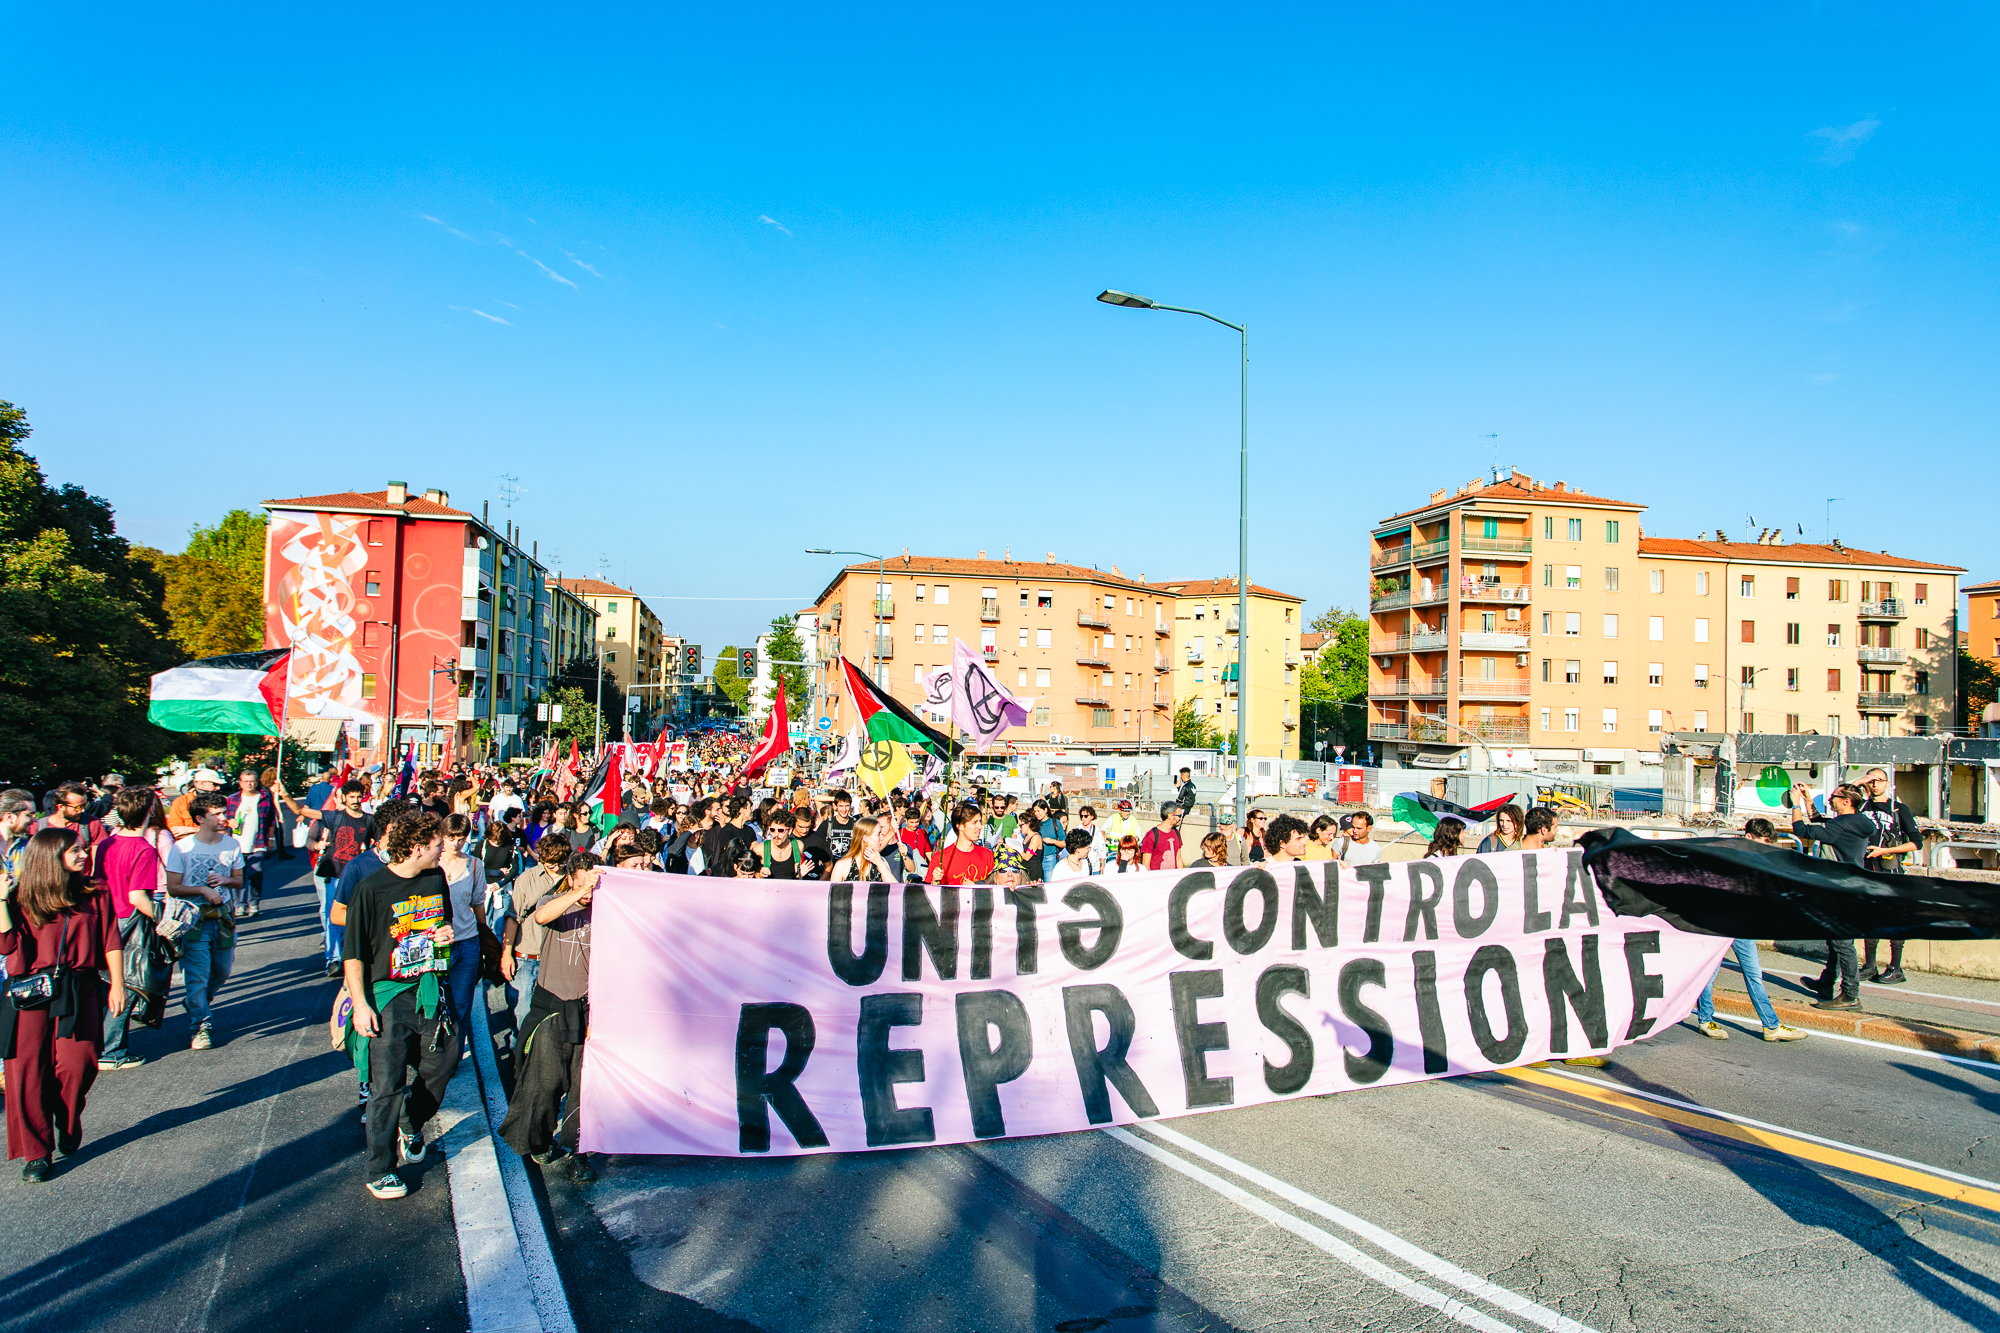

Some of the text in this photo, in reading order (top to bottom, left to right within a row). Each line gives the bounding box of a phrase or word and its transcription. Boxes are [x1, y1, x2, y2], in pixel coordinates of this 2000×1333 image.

[396, 895, 443, 915] Dream
[1167, 856, 1499, 961] CONTRO
[1522, 849, 1599, 935] LA
[734, 929, 1664, 1154] REPRESSIONE
